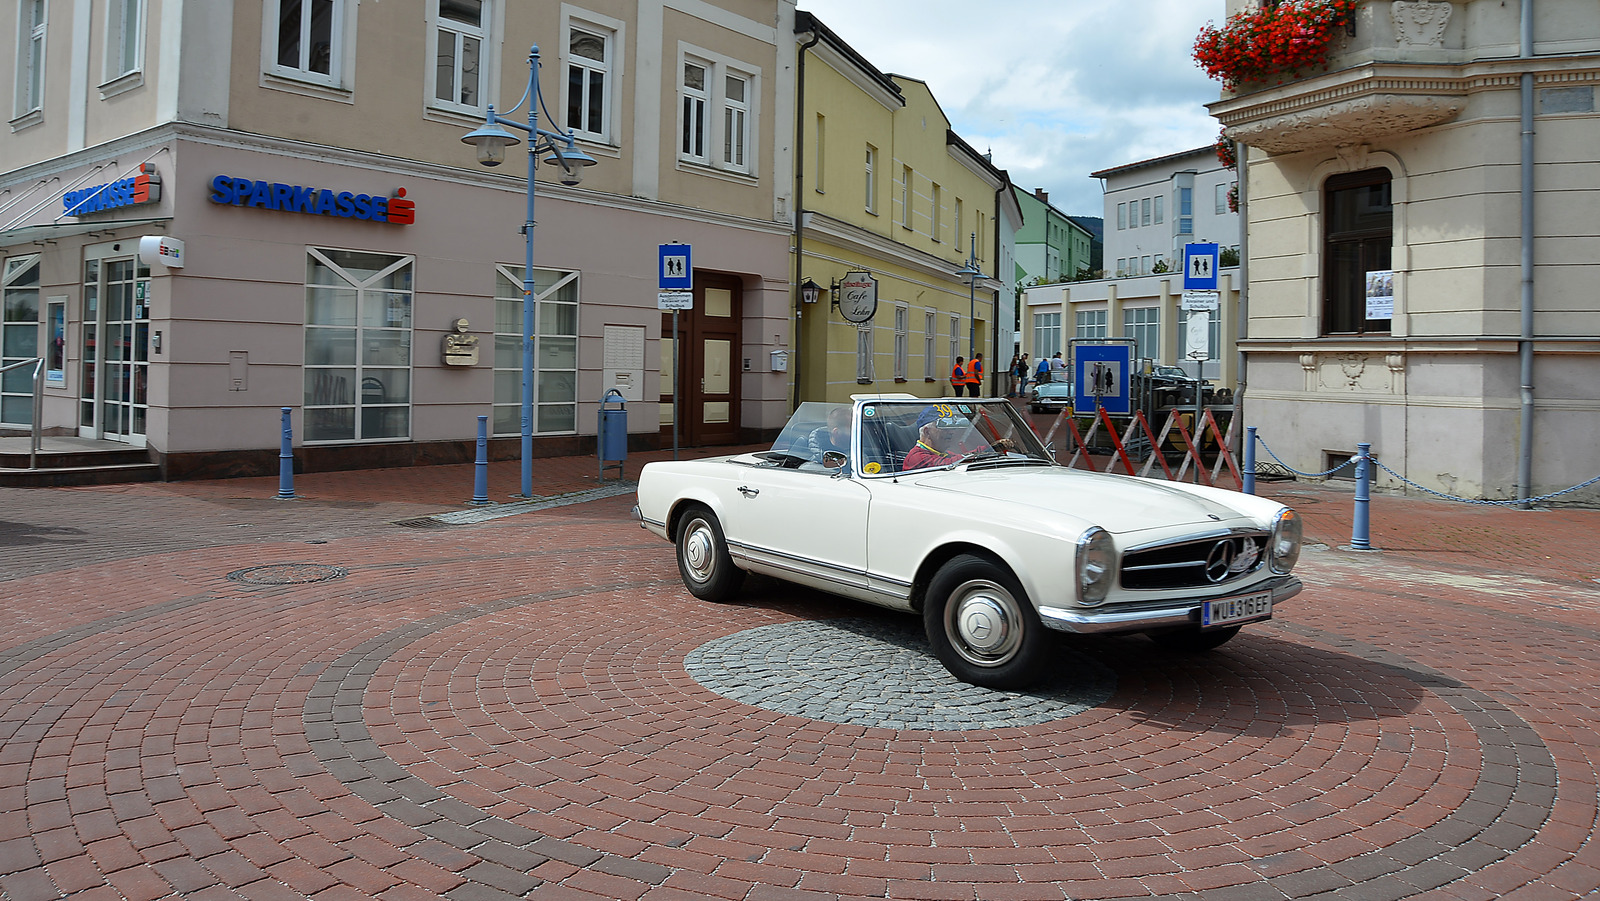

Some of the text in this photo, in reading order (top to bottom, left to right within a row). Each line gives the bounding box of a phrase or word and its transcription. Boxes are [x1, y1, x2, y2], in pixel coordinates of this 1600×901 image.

[63, 177, 135, 216] SPARKASSE
[211, 174, 388, 222] SPARKASSE
[846, 290, 867, 303] Cafe
[933, 404, 954, 418] 39
